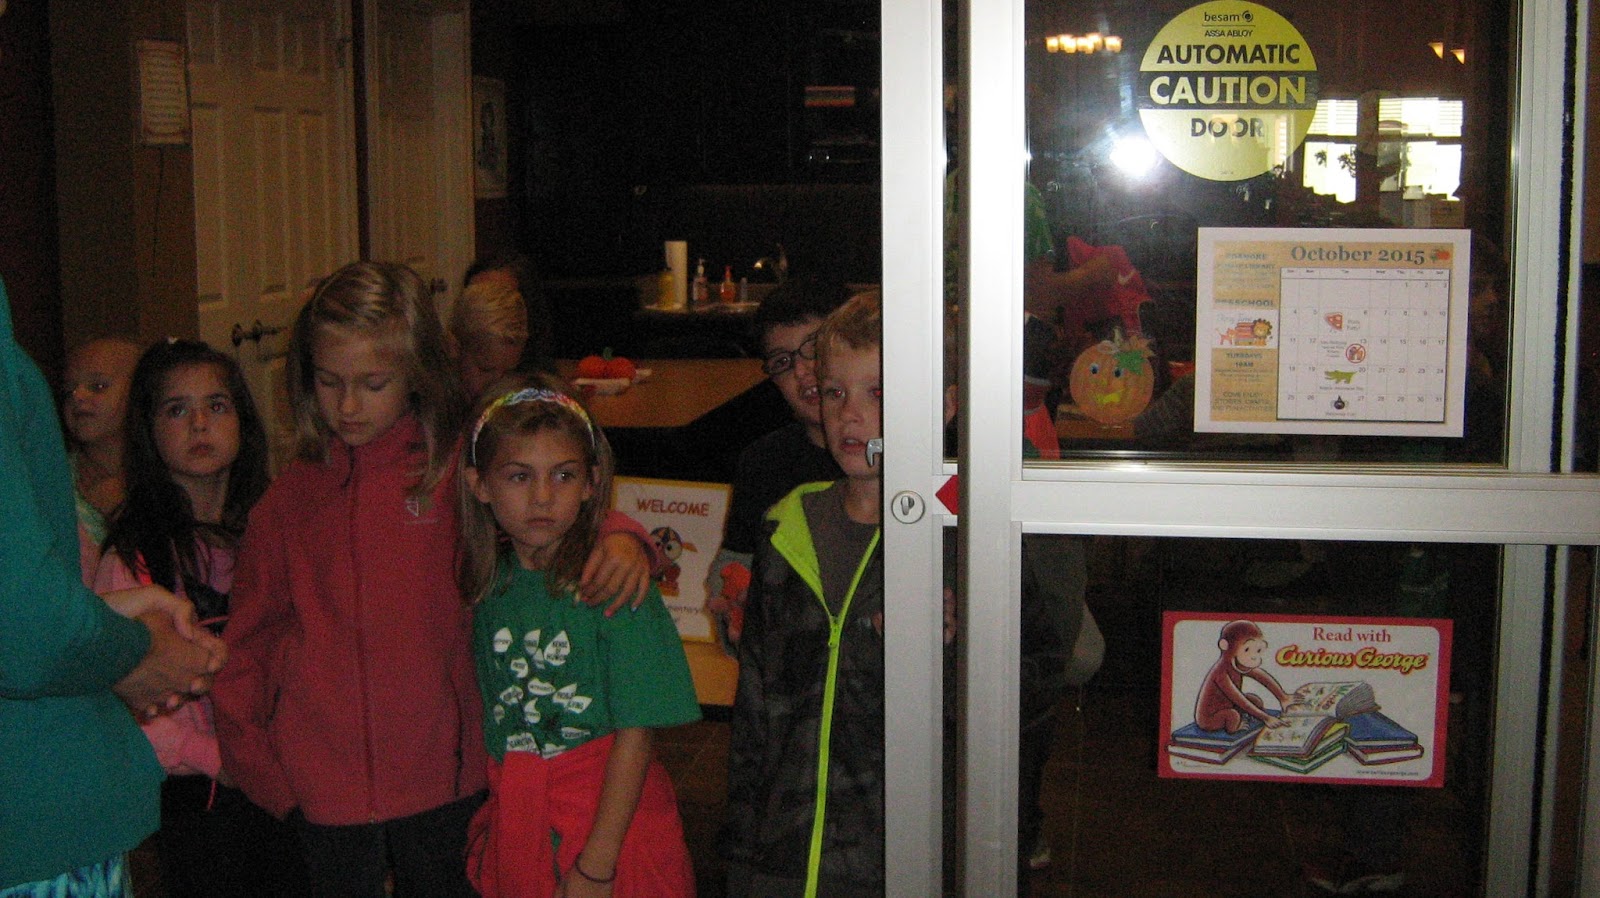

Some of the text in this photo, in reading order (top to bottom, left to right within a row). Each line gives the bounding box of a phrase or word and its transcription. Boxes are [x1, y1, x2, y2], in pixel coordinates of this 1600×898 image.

[1204, 12, 1240, 22] besam
[1157, 44, 1300, 64] AUTOMATIC
[1150, 76, 1306, 105] CAUTION
[1190, 117, 1264, 138] DOOR
[1291, 245, 1425, 265] October 2015
[636, 498, 711, 517] WELCOME
[1313, 626, 1391, 642] Read with
[1276, 644, 1427, 674] Curious George
